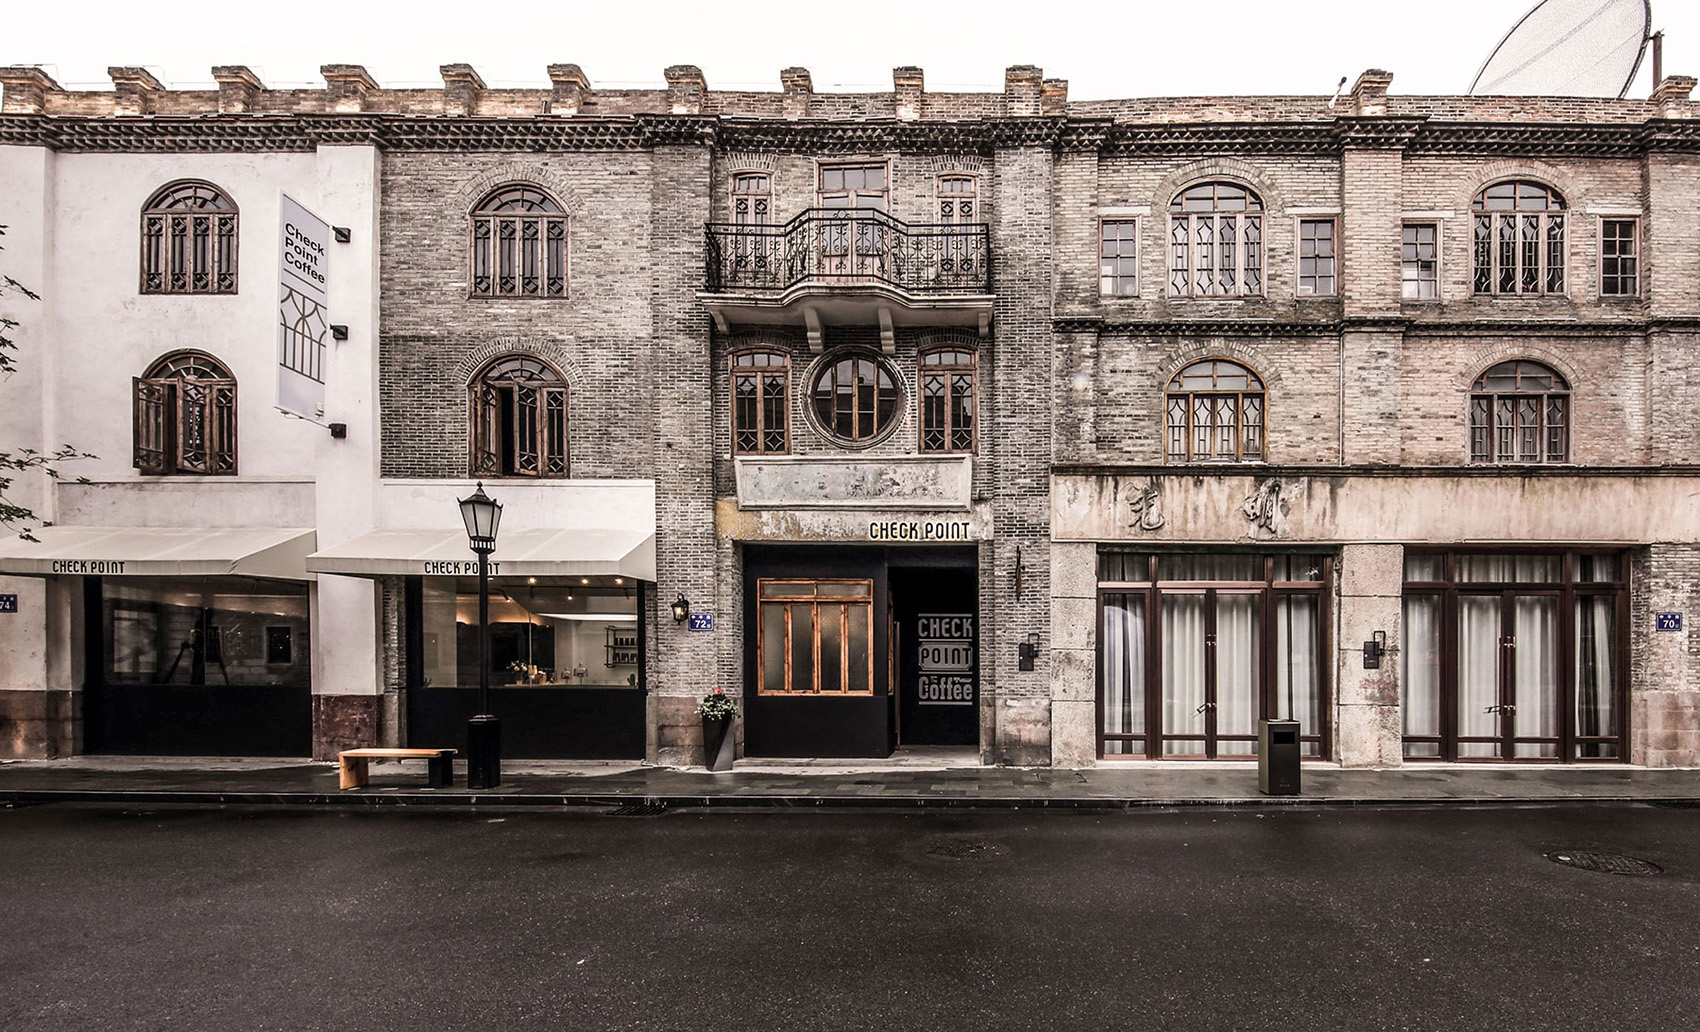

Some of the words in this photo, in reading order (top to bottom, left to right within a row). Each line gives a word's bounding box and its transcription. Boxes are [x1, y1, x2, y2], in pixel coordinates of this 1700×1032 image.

[285, 223, 325, 257] Check
[285, 236, 318, 267] Point
[284, 251, 325, 284] Coffee
[869, 521, 919, 540] CHECK
[924, 521, 970, 540] POINT
[52, 560, 87, 574] CHECK
[90, 560, 125, 574] POINT
[424, 561, 461, 574] CHECK
[464, 562, 500, 575] PONT
[695, 619, 707, 628] 72
[918, 618, 972, 637] CHECK
[1663, 619, 1675, 628] 70
[921, 647, 972, 665] POINT
[918, 676, 972, 699] Coffee
